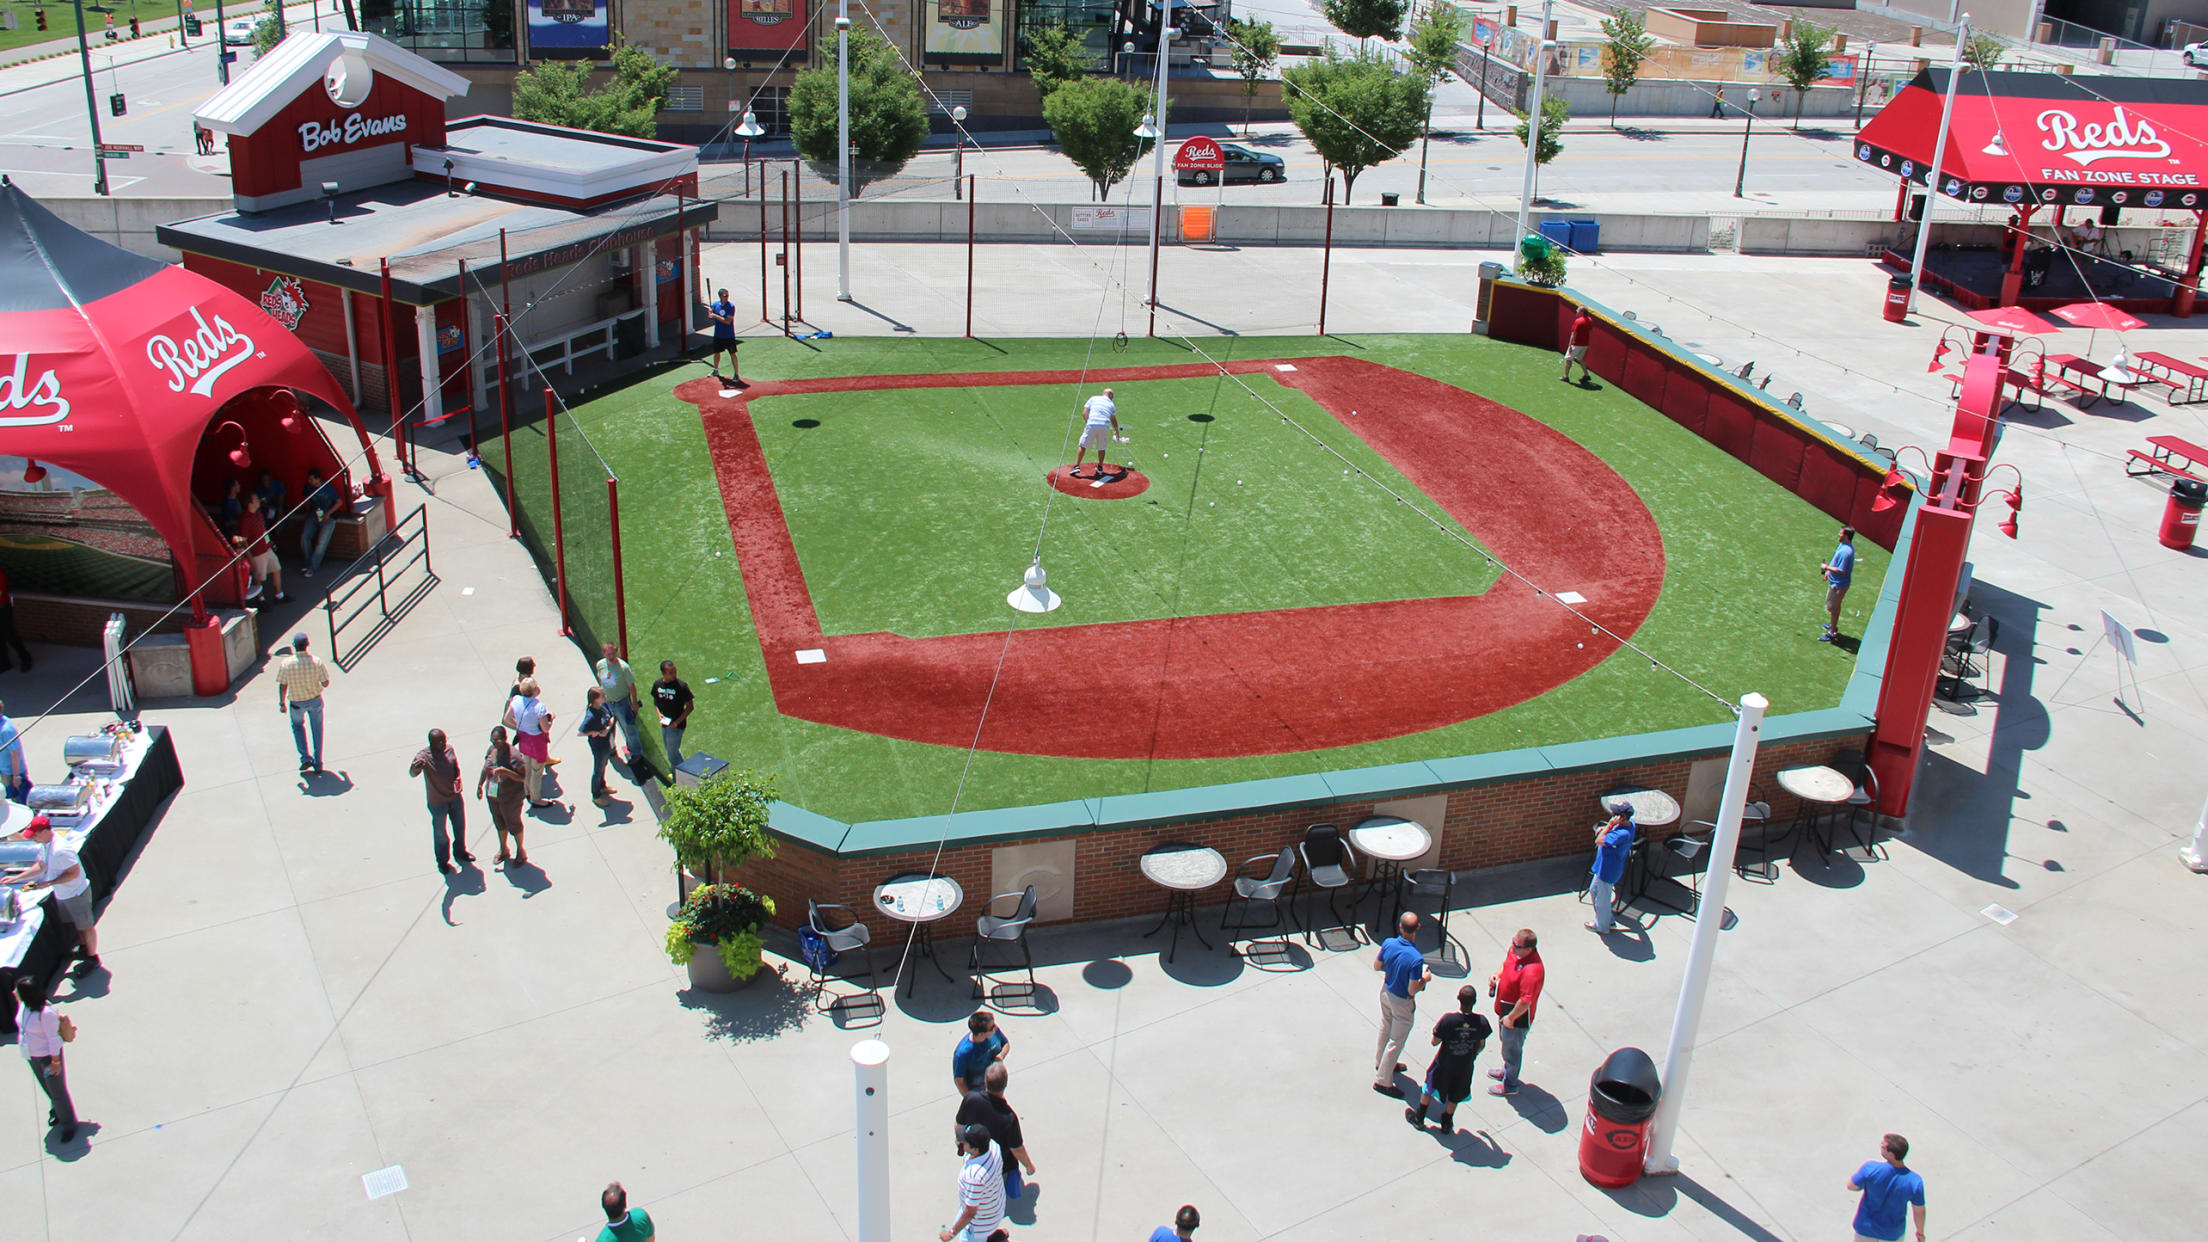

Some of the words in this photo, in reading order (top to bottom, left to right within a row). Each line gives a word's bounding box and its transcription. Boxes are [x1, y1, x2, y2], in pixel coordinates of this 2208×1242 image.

[562, 13, 577, 22] IPA
[298, 118, 342, 152] Bob
[343, 112, 407, 144] Evans
[2036, 105, 2171, 166] Reds
[1185, 143, 1216, 161] Reds
[2041, 168, 2081, 181] FAN
[2082, 171, 2136, 183] ZONE
[2138, 173, 2200, 185] STAGE
[1095, 207, 1115, 218] Reds
[544, 244, 585, 270] Heads
[262, 293, 283, 309] REDS
[147, 306, 255, 398] Reds
[0, 351, 71, 427] ds
[58, 424, 74, 432] TM
